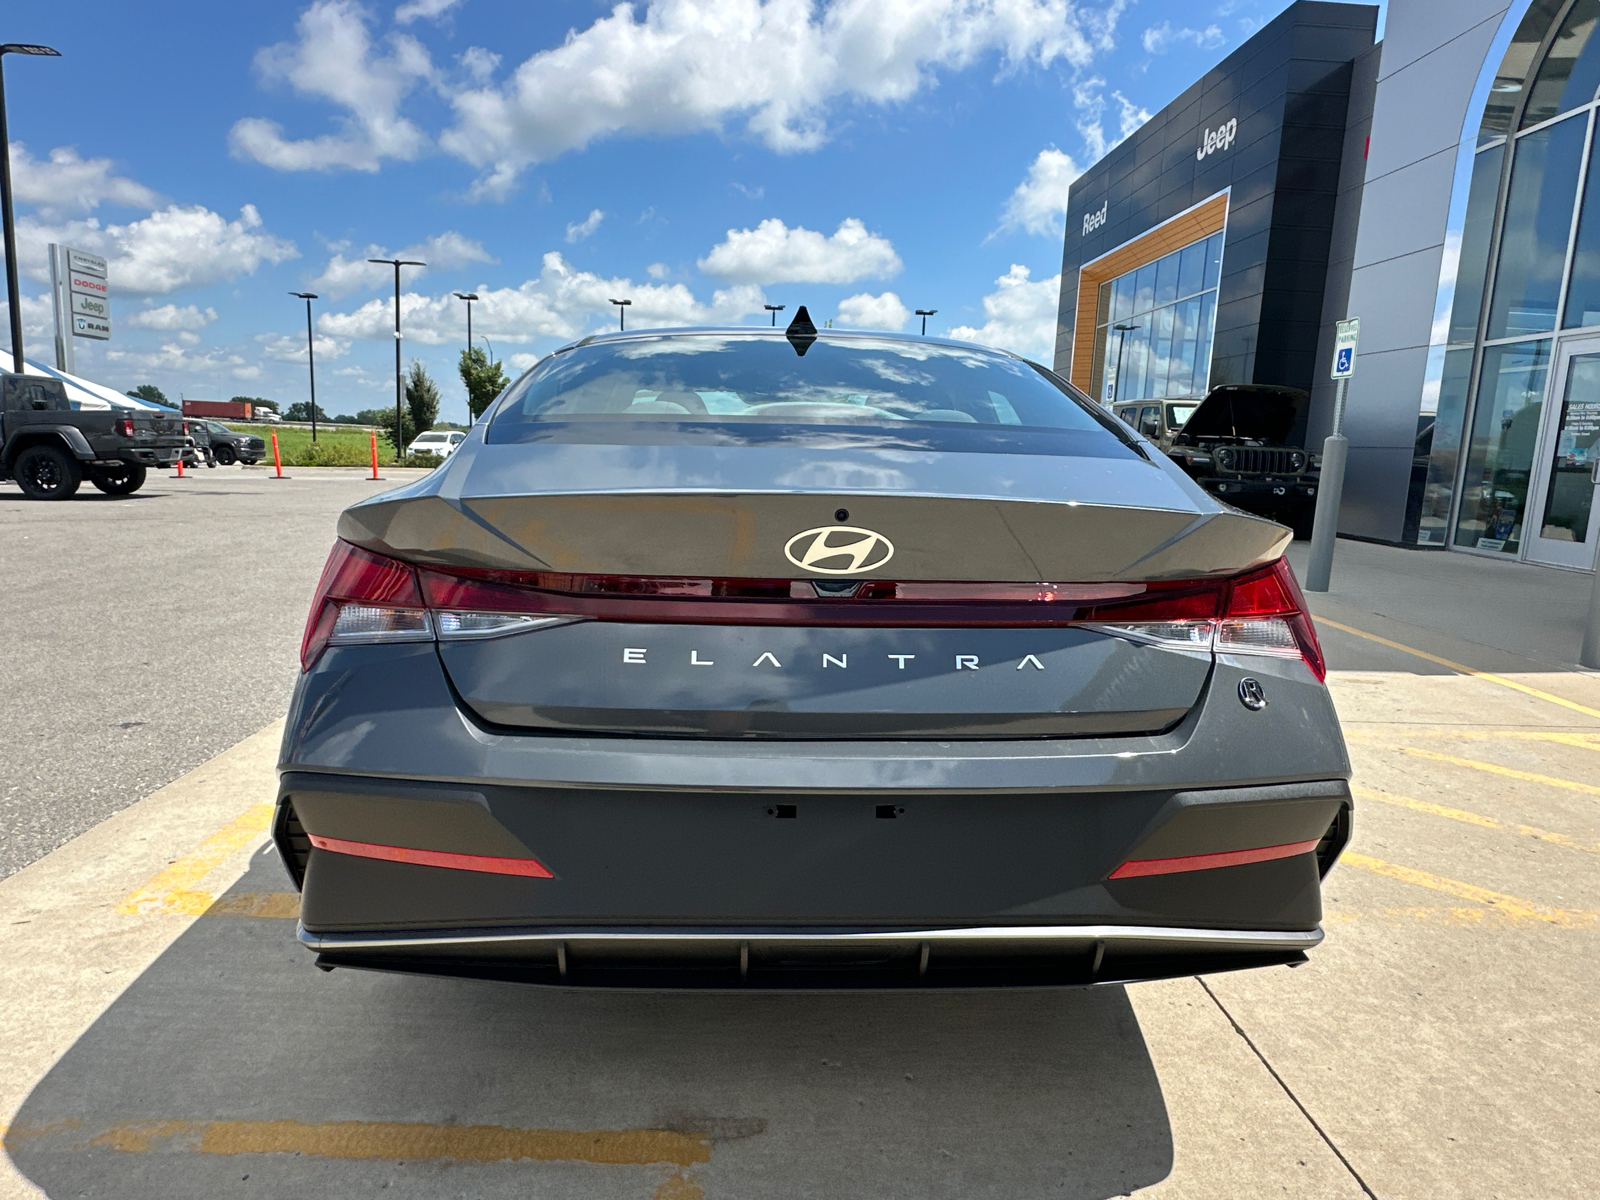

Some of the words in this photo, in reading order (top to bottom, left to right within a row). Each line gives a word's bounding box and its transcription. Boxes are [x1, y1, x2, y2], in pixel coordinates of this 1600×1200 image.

[1197, 117, 1237, 160] Jeep
[1082, 200, 1108, 236] Reed
[73, 255, 105, 267] CHRYSLER
[74, 279, 107, 292] DODGE
[81, 297, 104, 314] Jeep
[87, 322, 109, 332] RAM
[1338, 334, 1357, 343] PARKING
[622, 647, 1045, 670] ELANTRA
